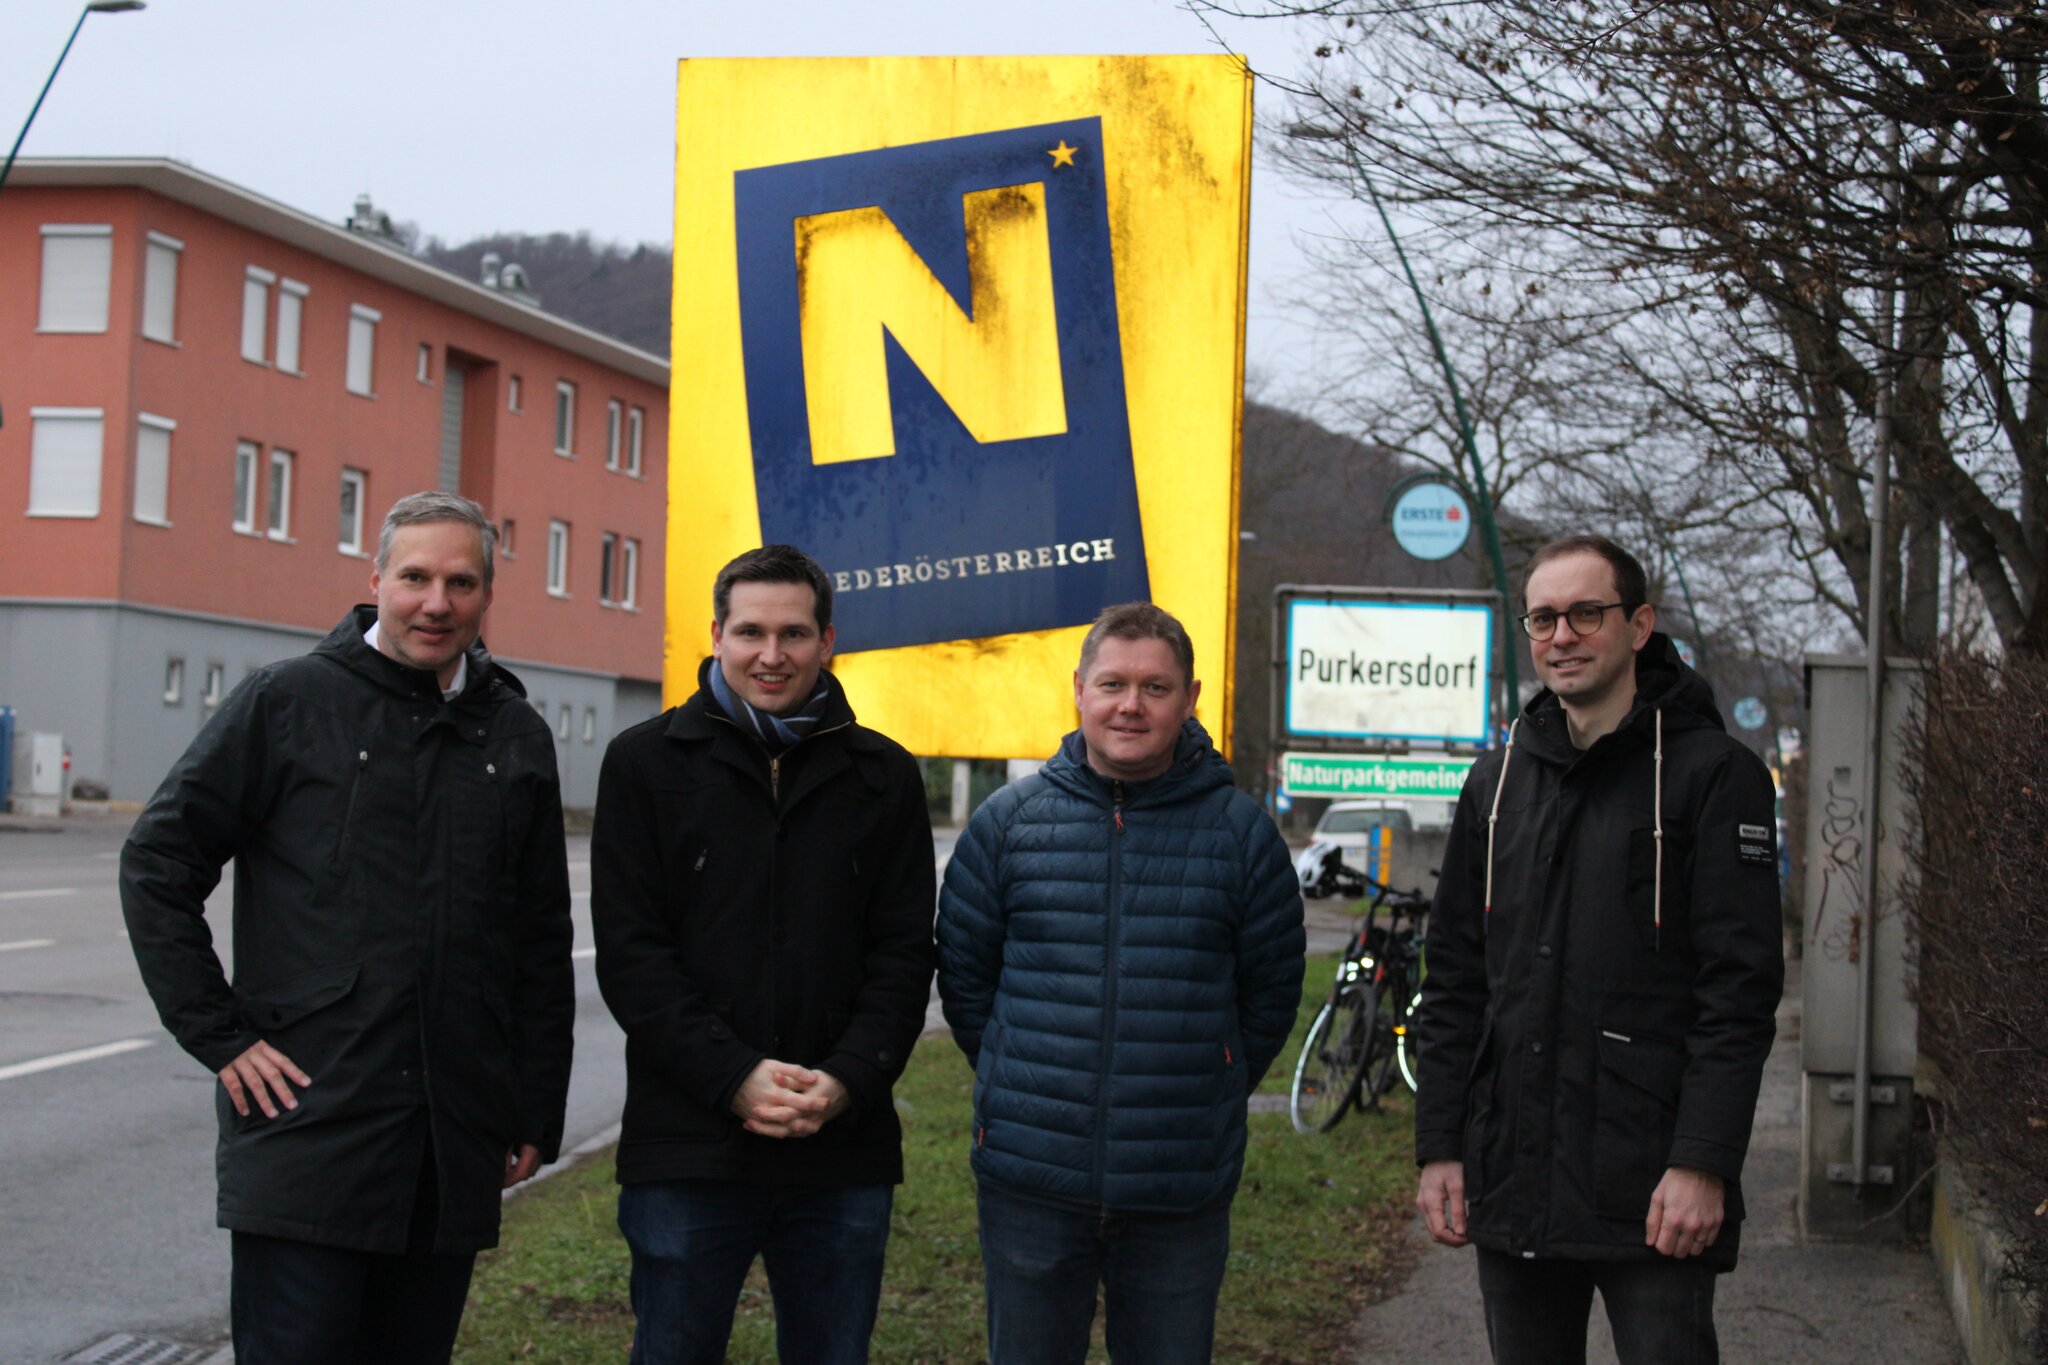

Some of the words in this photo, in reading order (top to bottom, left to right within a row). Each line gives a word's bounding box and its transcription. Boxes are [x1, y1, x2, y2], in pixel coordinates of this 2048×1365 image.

[793, 180, 1068, 466] N
[827, 537, 1116, 593] EDERÖSTERREICH
[1299, 648, 1477, 689] Purkersdorf
[1289, 761, 1471, 792] Naturparkgemeind
